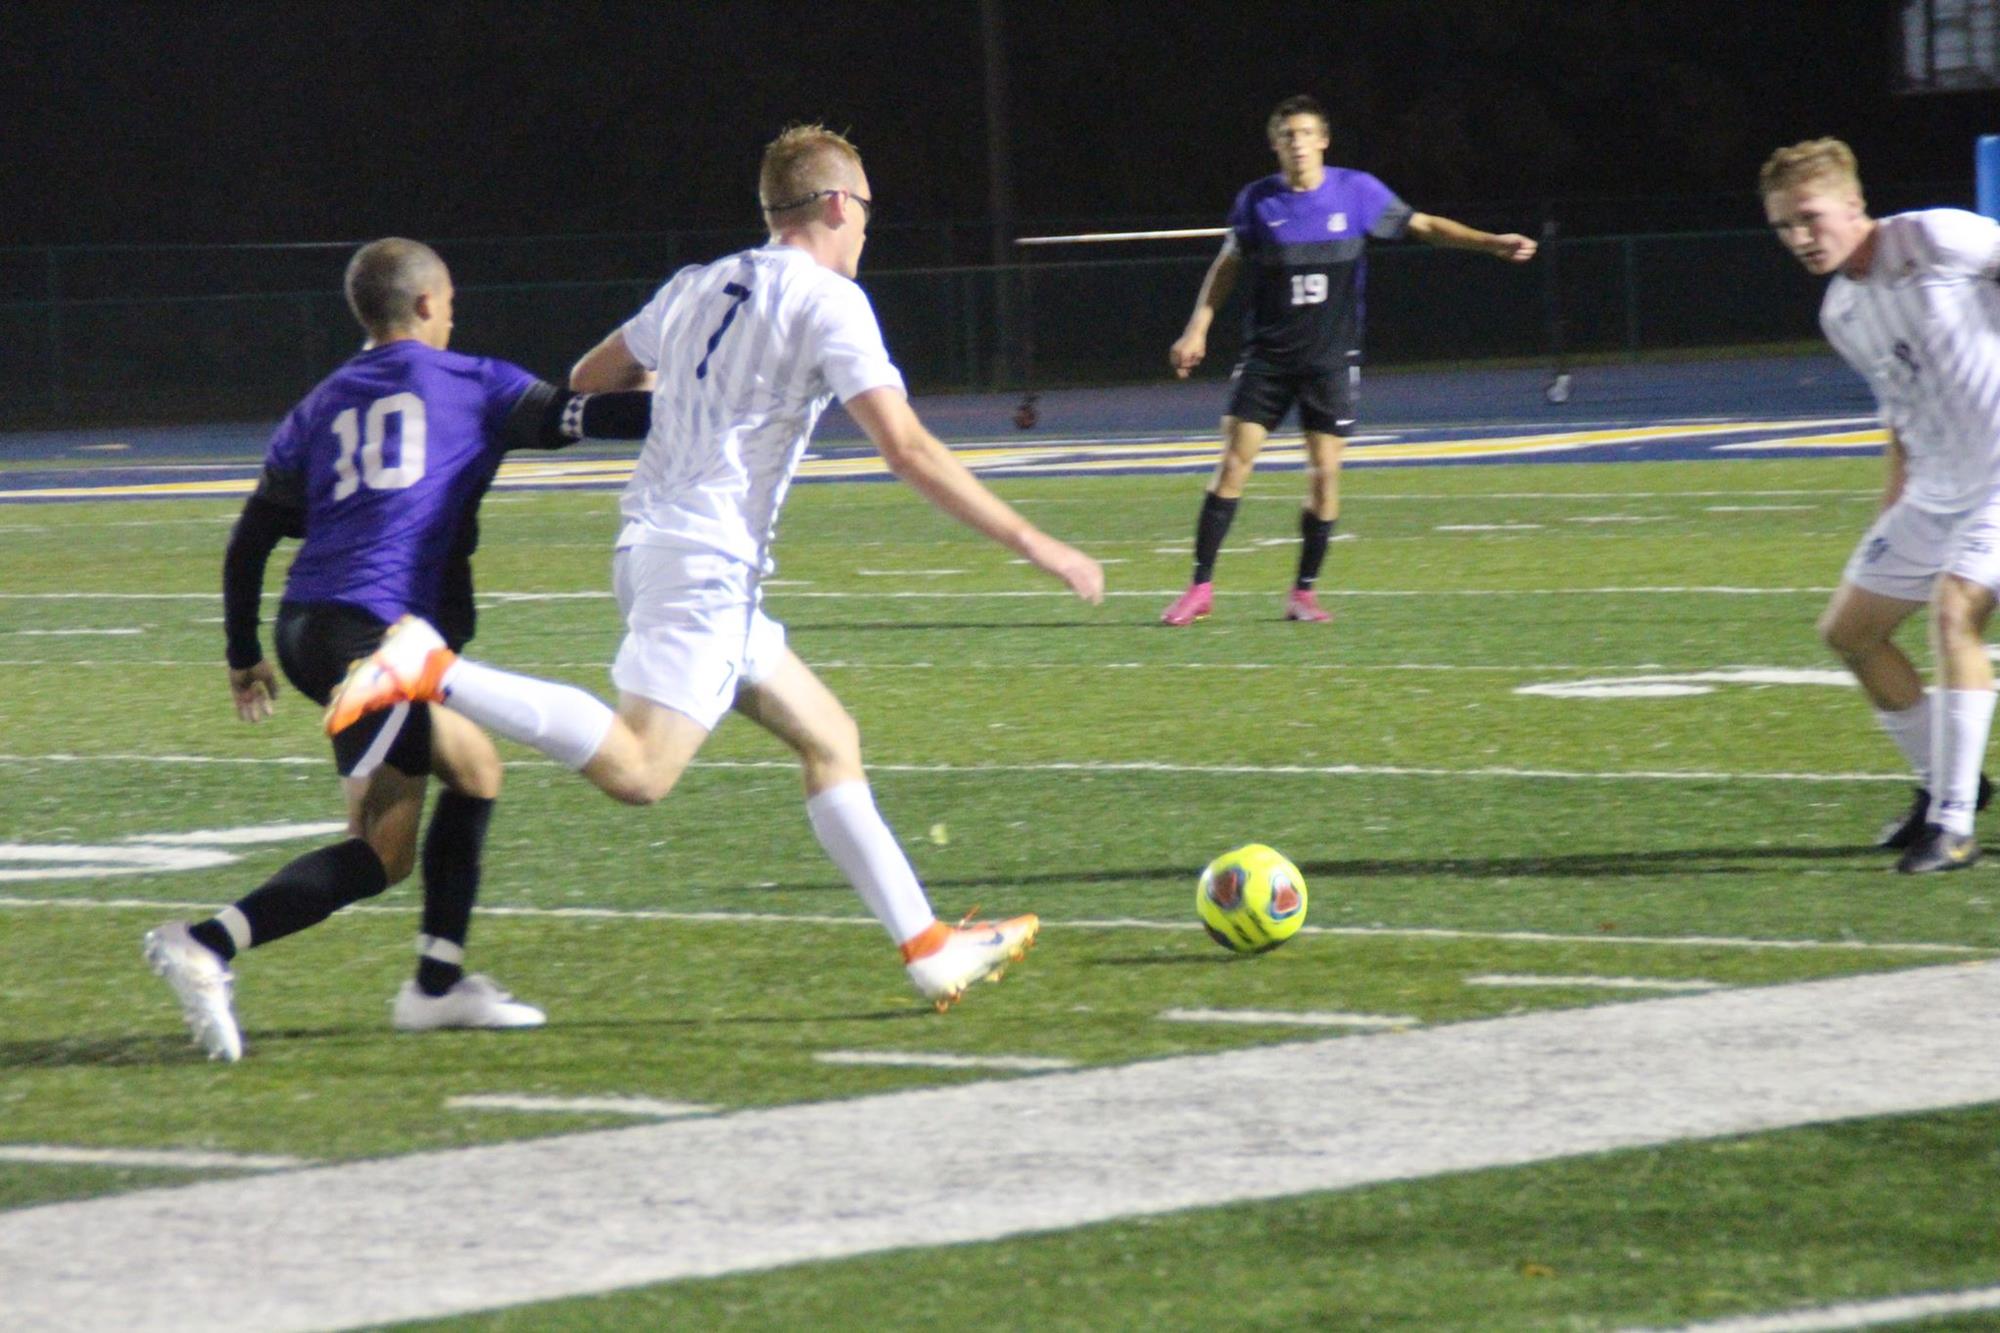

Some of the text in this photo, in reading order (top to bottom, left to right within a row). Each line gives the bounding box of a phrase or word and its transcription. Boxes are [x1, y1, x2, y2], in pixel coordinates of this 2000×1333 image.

[1290, 273, 1329, 305] 19
[696, 281, 752, 380] 7
[331, 391, 427, 501] 10
[716, 659, 735, 697] 7
